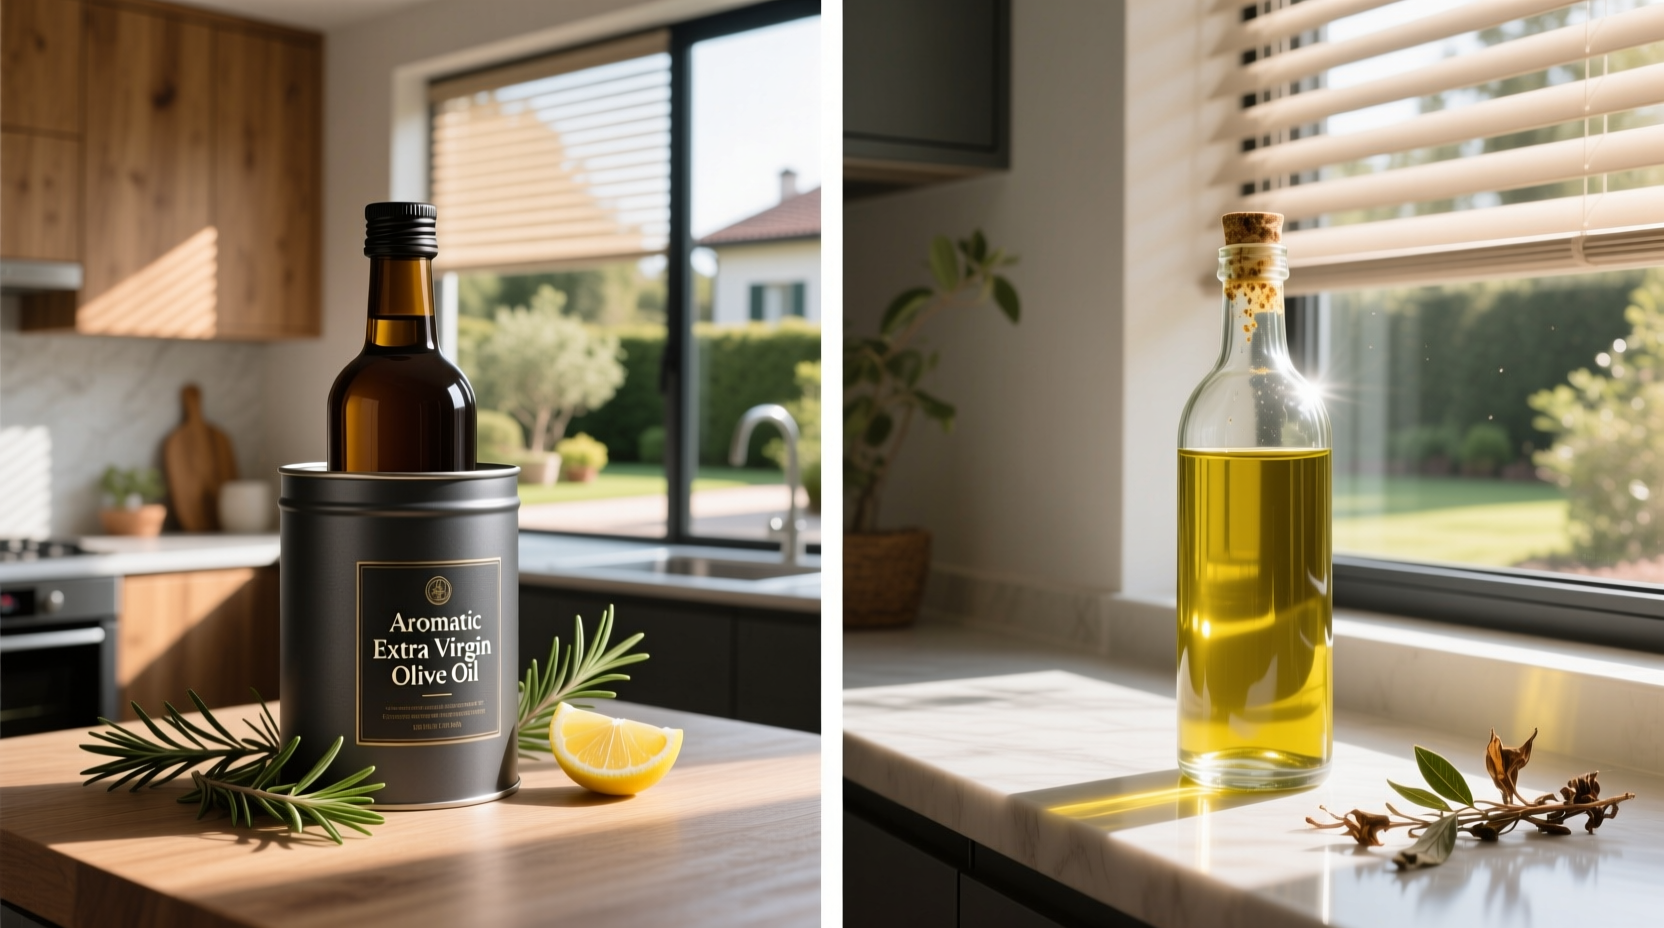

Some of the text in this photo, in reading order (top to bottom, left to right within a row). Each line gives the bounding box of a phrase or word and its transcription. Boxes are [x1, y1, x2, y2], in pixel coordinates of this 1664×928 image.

[389, 610, 482, 633] Aromatic
[373, 636, 492, 662] Extra Virgin
[391, 659, 479, 686] Olive Oil
